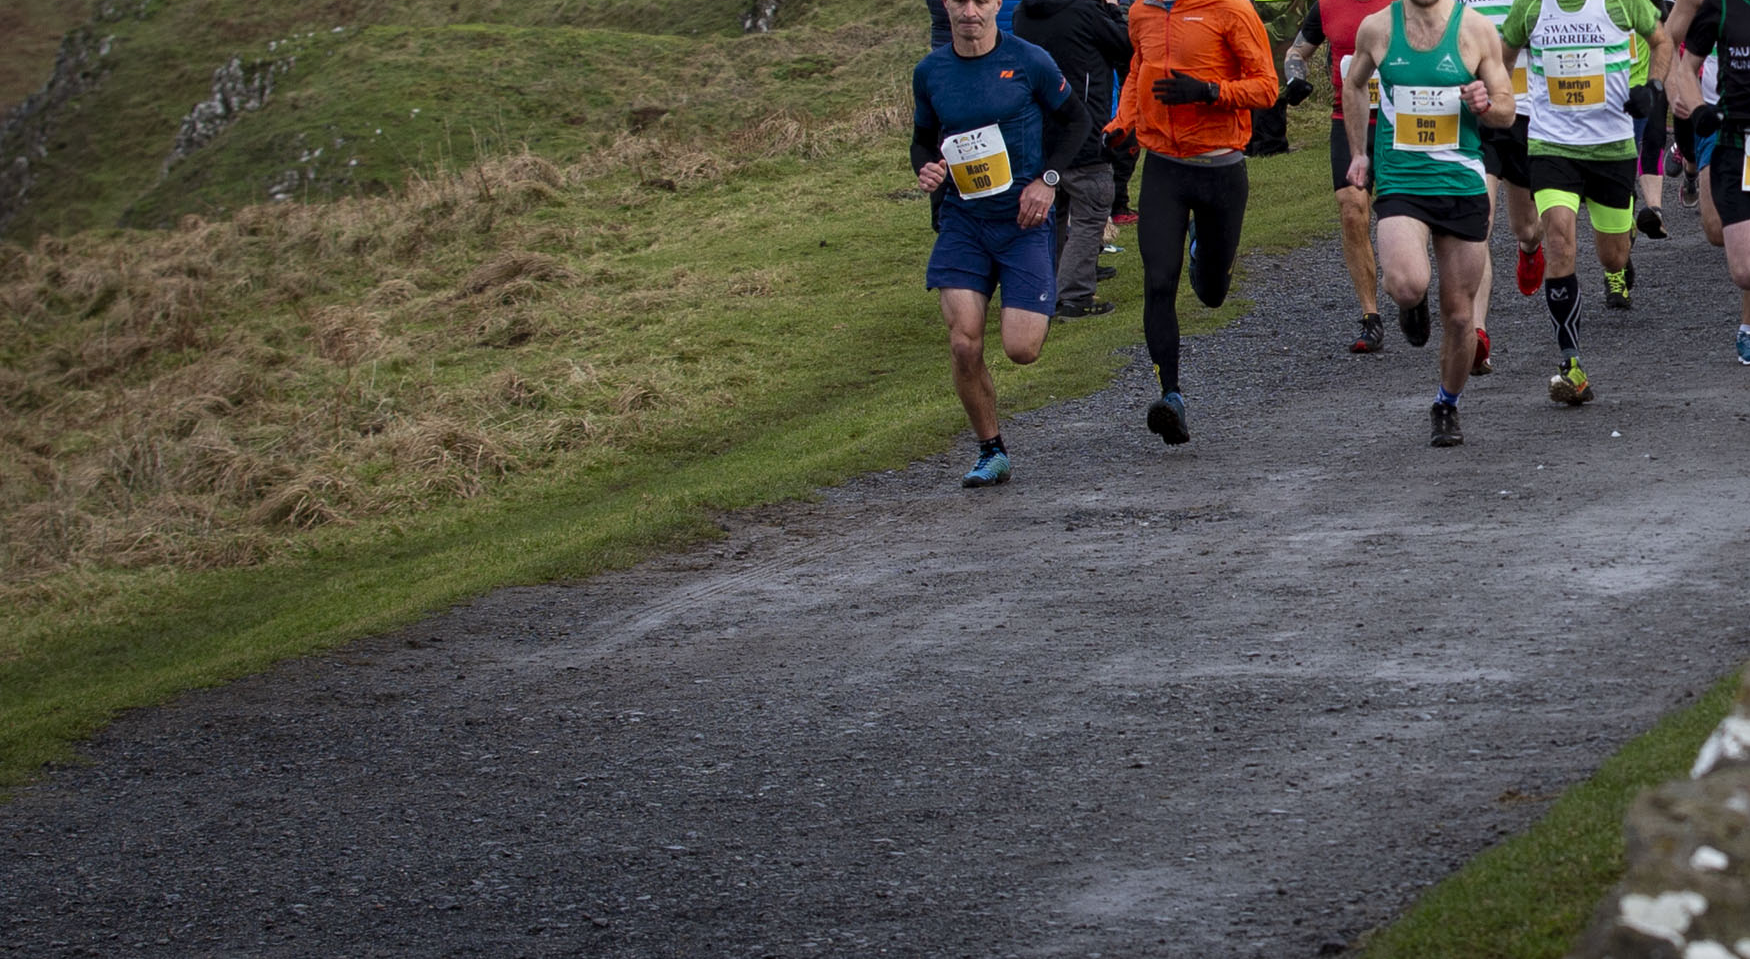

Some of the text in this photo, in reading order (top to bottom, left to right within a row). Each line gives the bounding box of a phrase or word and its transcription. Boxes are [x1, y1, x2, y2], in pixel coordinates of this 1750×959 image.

[1544, 23, 1602, 35] SWANSEA
[1541, 34, 1606, 45] HARRIERS
[1558, 80, 1591, 90] Martyn
[1566, 91, 1585, 104] 215
[1416, 118, 1436, 129] Ben
[1417, 132, 1435, 143] 174
[966, 162, 990, 176] Marc
[972, 174, 992, 189] 100
